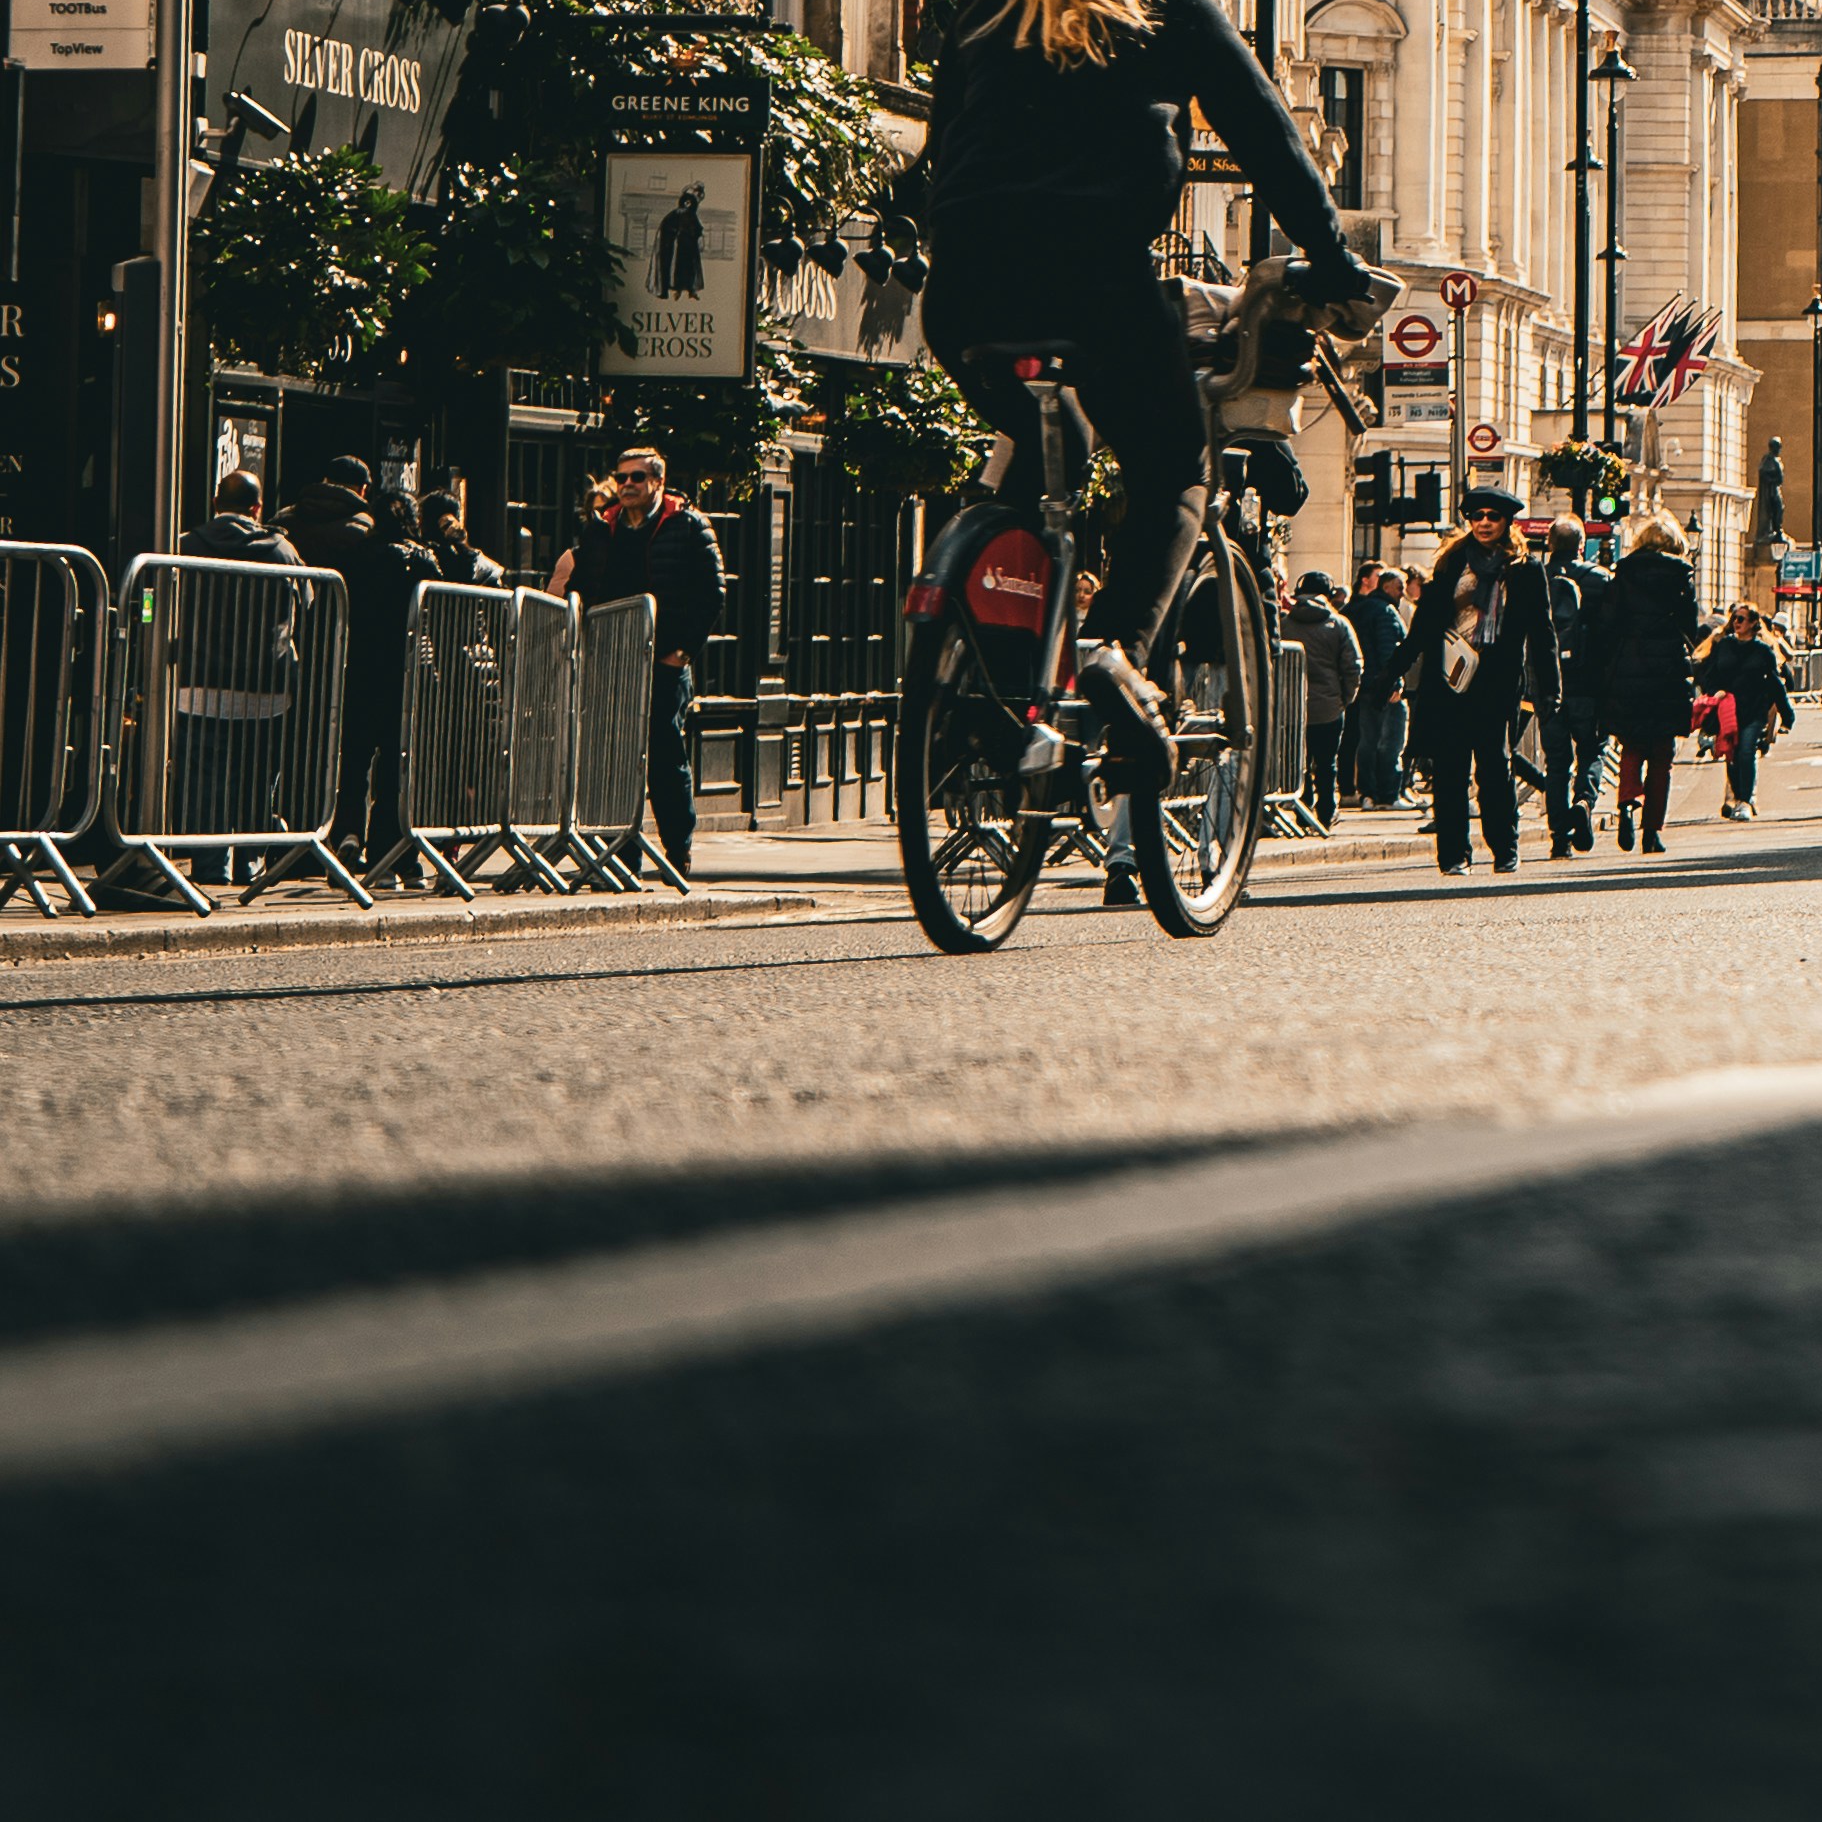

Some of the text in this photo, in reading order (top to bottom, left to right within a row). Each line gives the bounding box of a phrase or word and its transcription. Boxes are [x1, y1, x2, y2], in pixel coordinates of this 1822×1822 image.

[49, 2, 107, 15] TOOTBus
[51, 42, 104, 56] TopView
[284, 28, 421, 114] SILVER CROSS
[612, 95, 750, 113] GREENE KING
[1447, 279, 1471, 303] M
[631, 311, 715, 333] SILVER
[635, 336, 713, 359] CROSS
